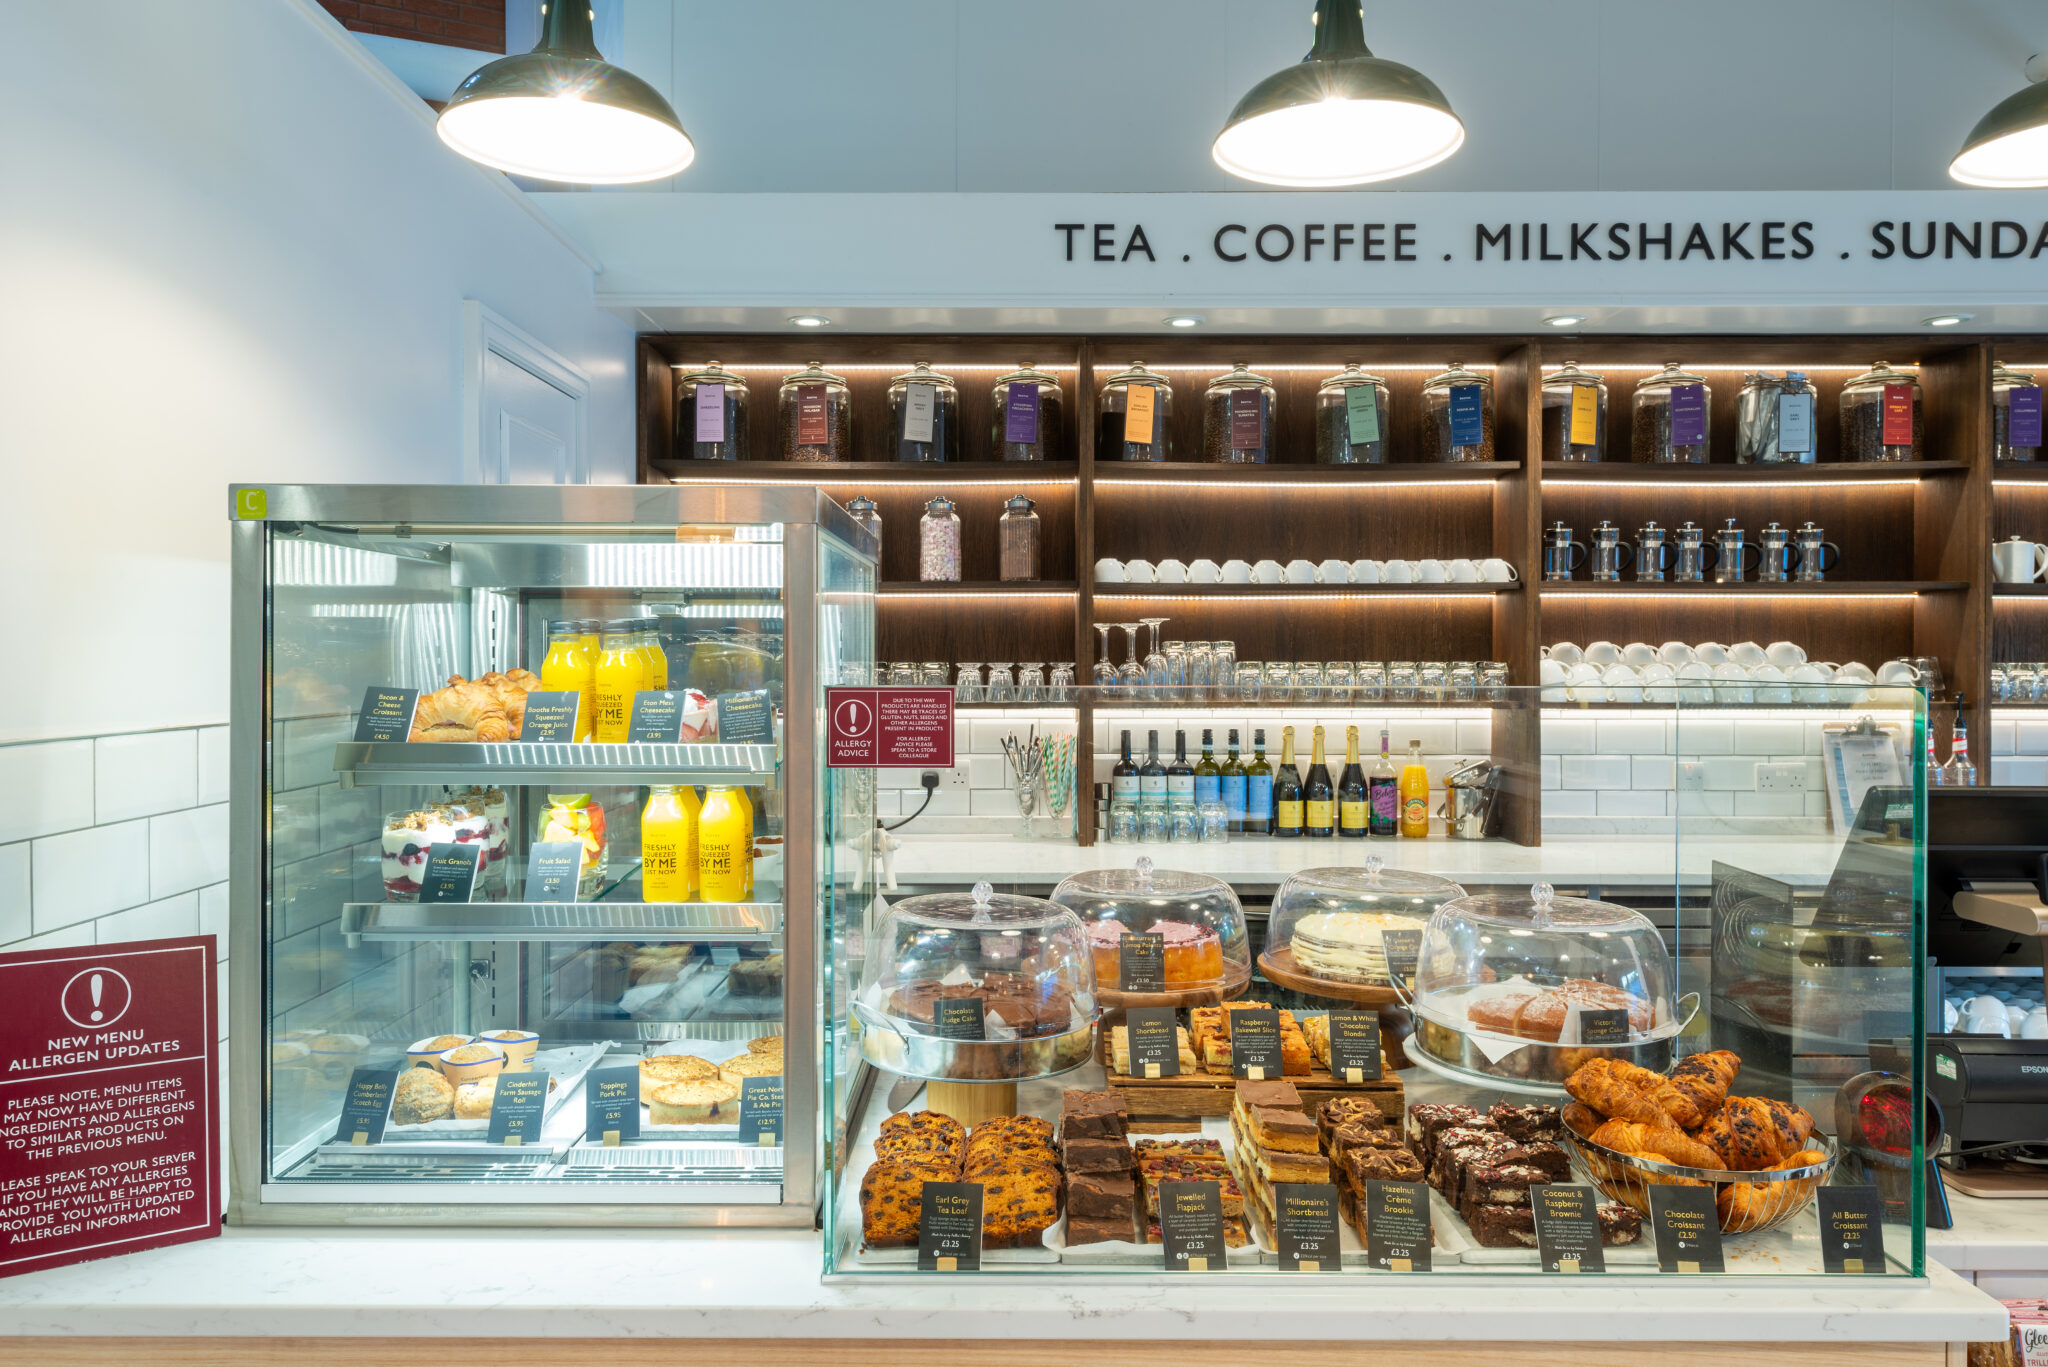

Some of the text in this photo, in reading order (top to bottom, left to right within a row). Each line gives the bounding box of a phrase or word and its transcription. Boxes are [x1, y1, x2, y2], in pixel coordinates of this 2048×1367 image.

[1054, 224, 1156, 262] TEA
[1213, 224, 1418, 262] COFFEE
[1476, 221, 1815, 261] MILKSHAKES
[378, 701, 401, 709] Cheese
[373, 708, 402, 716] Croissant
[551, 706, 573, 715] Freshly
[606, 709, 623, 719] ME
[535, 713, 565, 721] Squeezed
[528, 721, 569, 729] Orange Juice
[448, 858, 473, 866] Granola
[659, 858, 677, 868] ME
[713, 858, 731, 868] ME
[1240, 1019, 1270, 1027] Raspberry
[47, 1029, 145, 1051] NEW MENU
[9, 1039, 180, 1071] ALLERGEN UPDATES
[600, 1082, 627, 1090] Toppings
[7, 1077, 182, 1109] PLEASE NOTE, MENU ITEMS
[518, 1089, 542, 1097] Sausage
[4, 1089, 186, 1124] MAY NOW HAVE DIFFERENT
[90, 1112, 120, 1125] AND
[123, 1101, 195, 1120] ALLERGENS
[6, 1115, 184, 1150] TO SIMILAR PRODUCTS ON
[26, 1131, 168, 1161] THE PREVIOUS MENU.
[1, 1151, 196, 1192] LEASE SPEAK TO YOUR SERVER
[2, 1166, 188, 1204] IF YOU HAVE ANY ALLERGIES
[1381, 1185, 1415, 1195] Hazelnut
[1542, 1189, 1583, 1198] Coconut &
[0, 1177, 192, 1219] AND THEY WILL BE HAPPY TO
[935, 1196, 970, 1206] Earl Grey
[1176, 1193, 1206, 1203] Jewelled
[1285, 1198, 1329, 1206] Millionaire's
[1385, 1195, 1412, 1204] Crème
[61, 1208, 92, 1221] YOU
[94, 1202, 131, 1216] WITH
[135, 1190, 195, 1209] UPDATED
[1176, 1204, 1206, 1213] Flapjack
[1545, 1199, 1583, 1210] Raspberry
[937, 1206, 949, 1214] Tea
[1287, 1207, 1328, 1217] Shortbread
[1384, 1206, 1414, 1215] Brookie
[1550, 1210, 1582, 1218] Brownie
[1664, 1210, 1705, 1219] Chocolate
[1832, 1211, 1868, 1219] All Butter
[10, 1204, 181, 1244] ALLERGEN INFORMATION
[1667, 1220, 1705, 1229] Croissant
[1833, 1222, 1869, 1230] Croissant
[1678, 1231, 1697, 1239] £2.50
[941, 1240, 960, 1248] £3.25
[1391, 1249, 1409, 1257] £3.25
